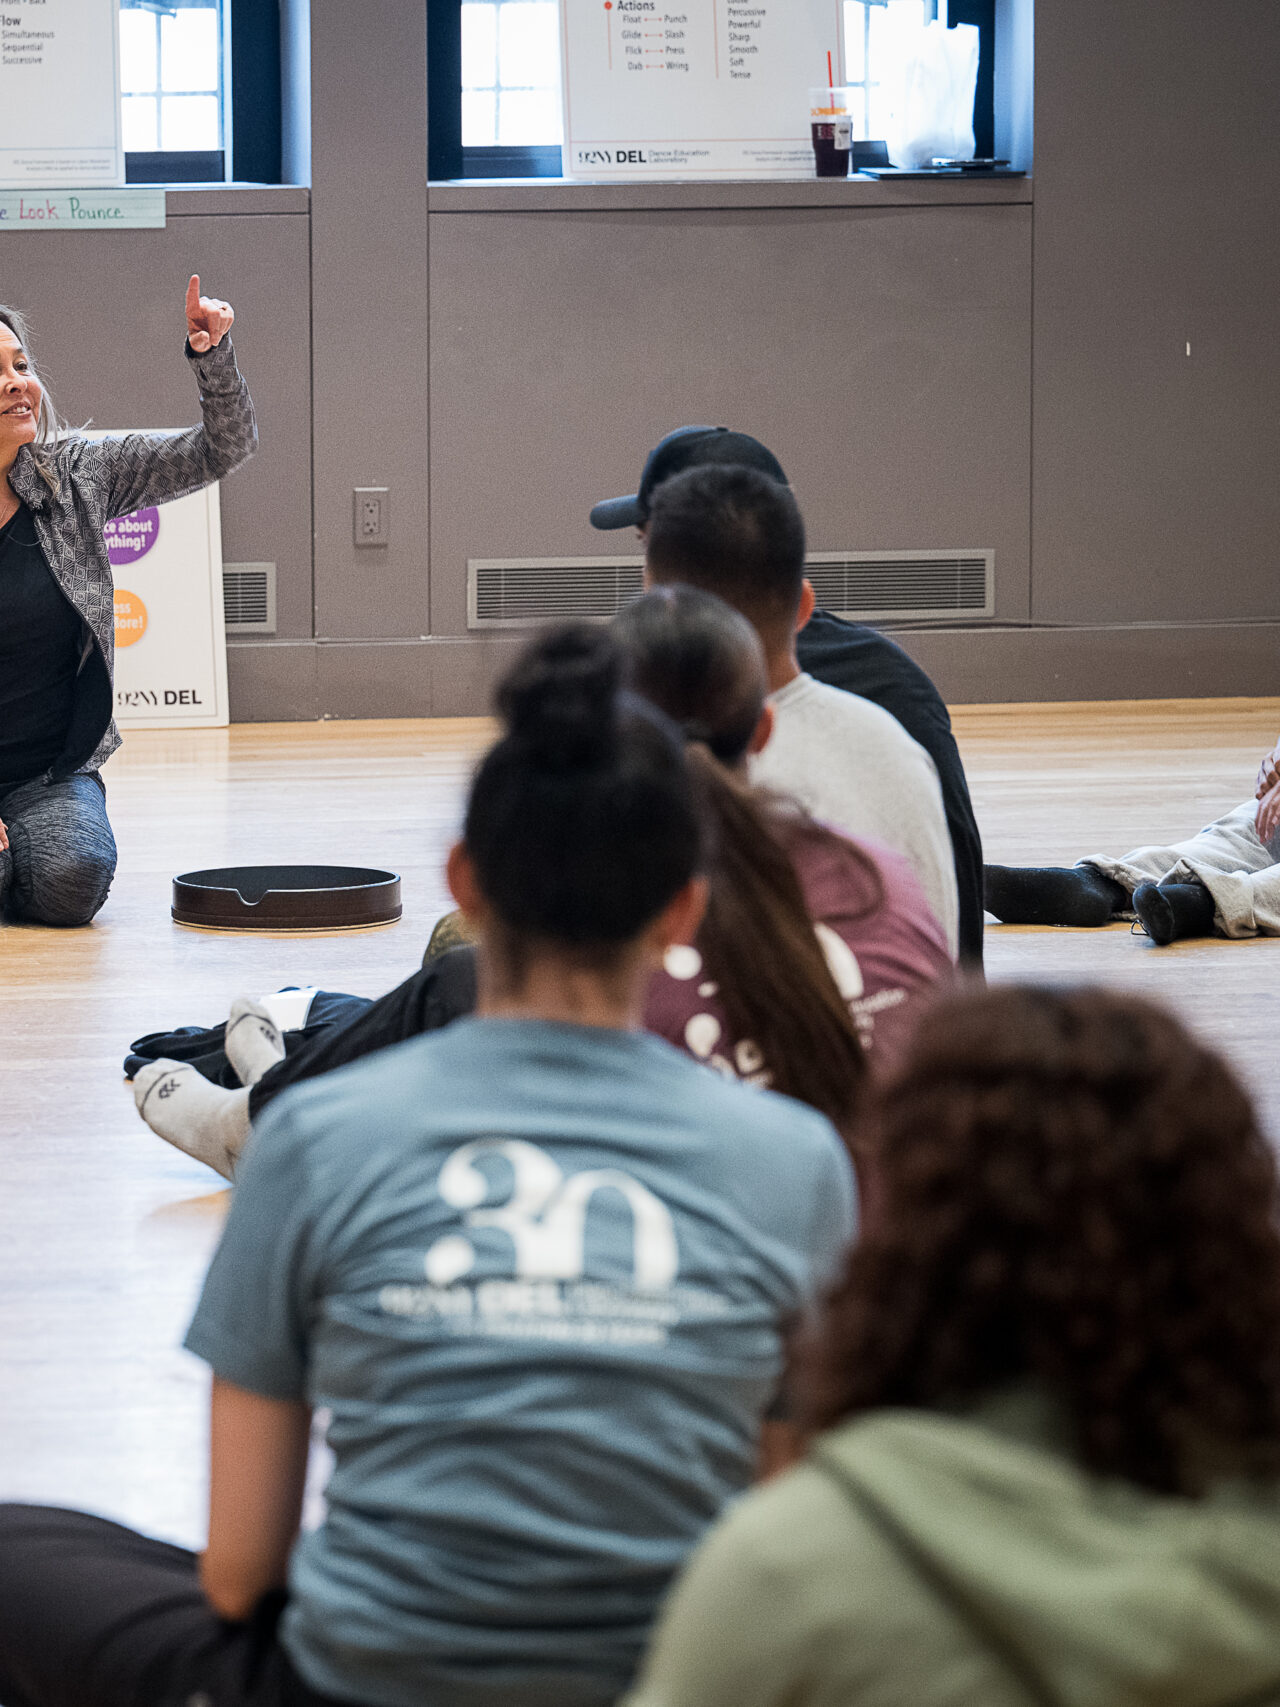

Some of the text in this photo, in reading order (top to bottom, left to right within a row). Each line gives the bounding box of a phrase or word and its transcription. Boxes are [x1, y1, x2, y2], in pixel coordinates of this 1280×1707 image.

[617, 1, 655, 11] Actions
[727, 8, 766, 16] Percussive
[664, 15, 687, 23] Punch
[728, 21, 761, 29] Powerful
[1, 30, 54, 39] Simultaneous
[729, 33, 750, 42] Sharp
[2, 43, 43, 53] Sequential
[729, 46, 758, 54] Smooth
[2, 56, 42, 64] Successive
[616, 150, 647, 163] DEL
[20, 198, 58, 220] Look
[69, 197, 124, 220] Pounce
[118, 520, 153, 533] about
[165, 690, 202, 705] DEL
